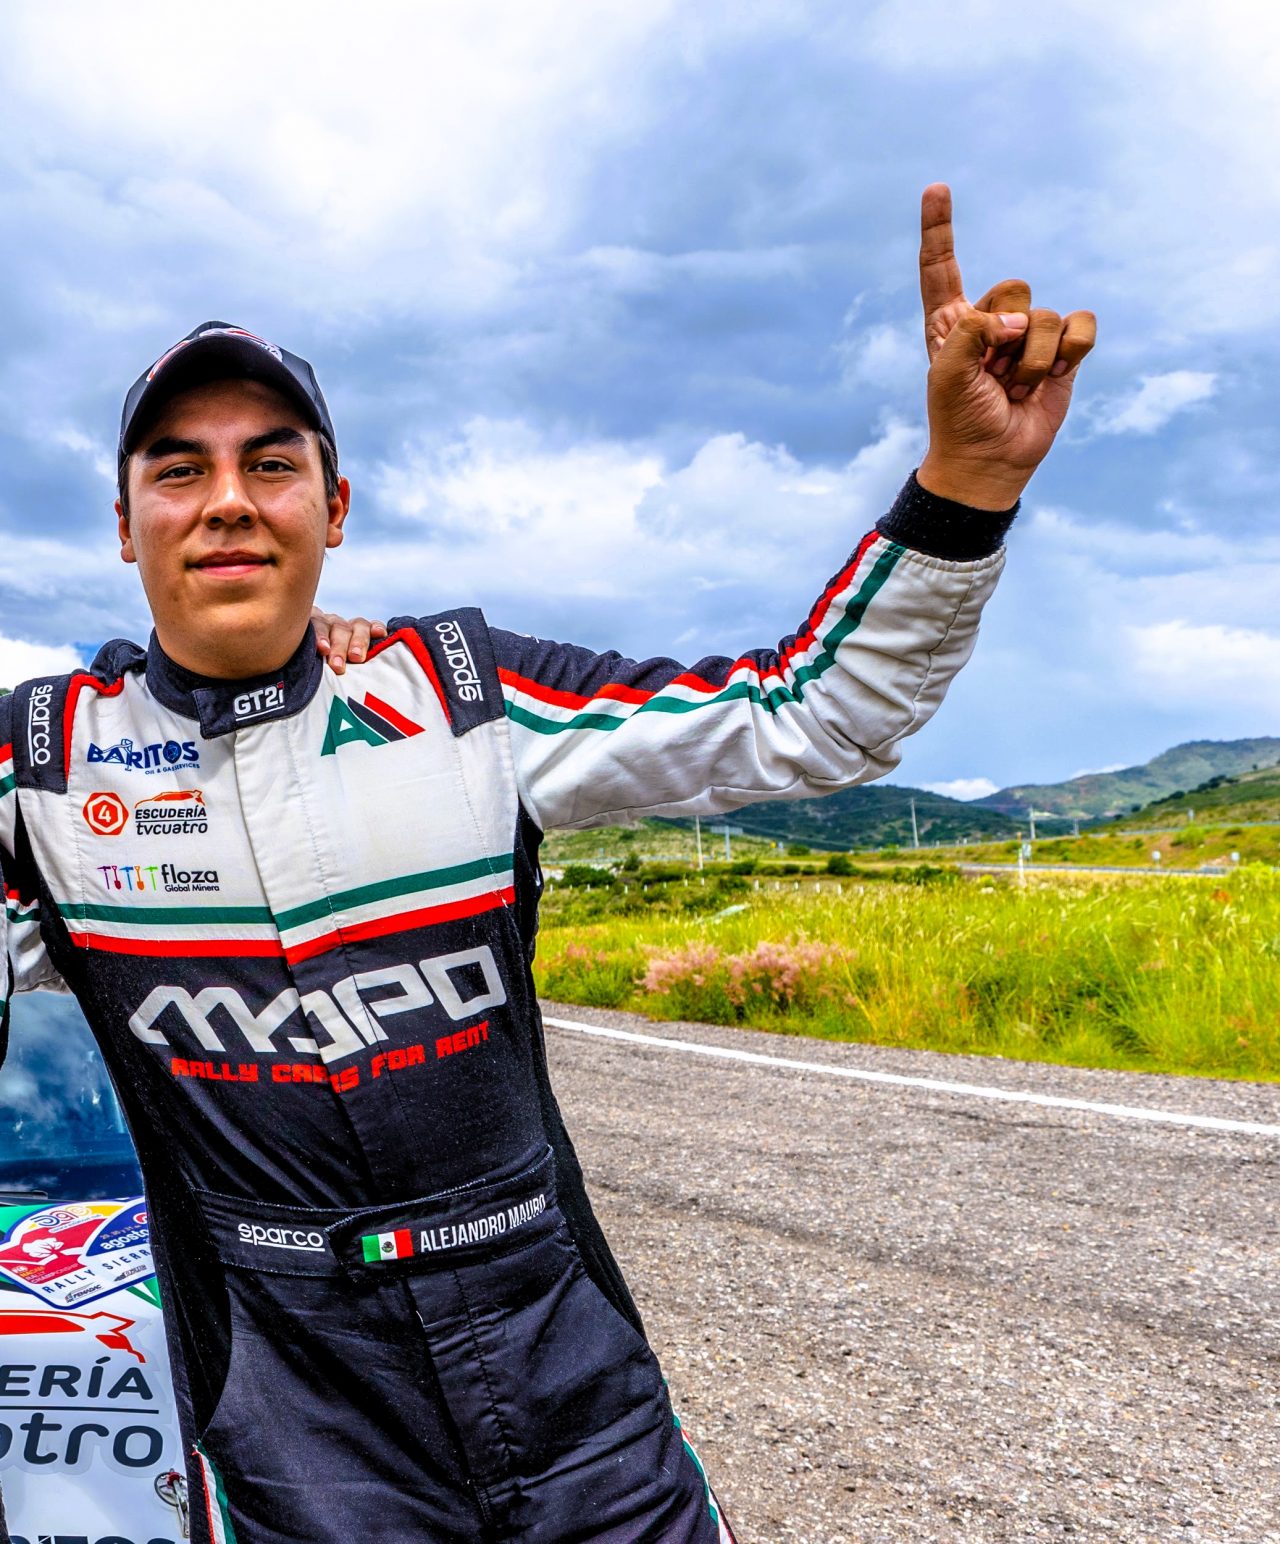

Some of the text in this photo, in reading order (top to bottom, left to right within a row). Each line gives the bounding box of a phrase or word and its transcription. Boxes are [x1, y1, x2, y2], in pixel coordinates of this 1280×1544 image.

[435, 620, 483, 701] sparco
[29, 684, 54, 766] sparco
[87, 739, 200, 769] BARITOS
[97, 804, 112, 823] 4
[134, 805, 208, 820] ESCUDERÍA
[136, 821, 209, 836] tvcuatro
[161, 864, 220, 884] floza
[164, 884, 220, 893] Global Minera
[171, 1058, 259, 1082] RALLY
[371, 1045, 426, 1079] FOR
[436, 1020, 490, 1058] RENT
[238, 1222, 324, 1249] sparco
[420, 1193, 546, 1253] ALEJANDRO MAURO
[42, 1269, 96, 1294] RALLY
